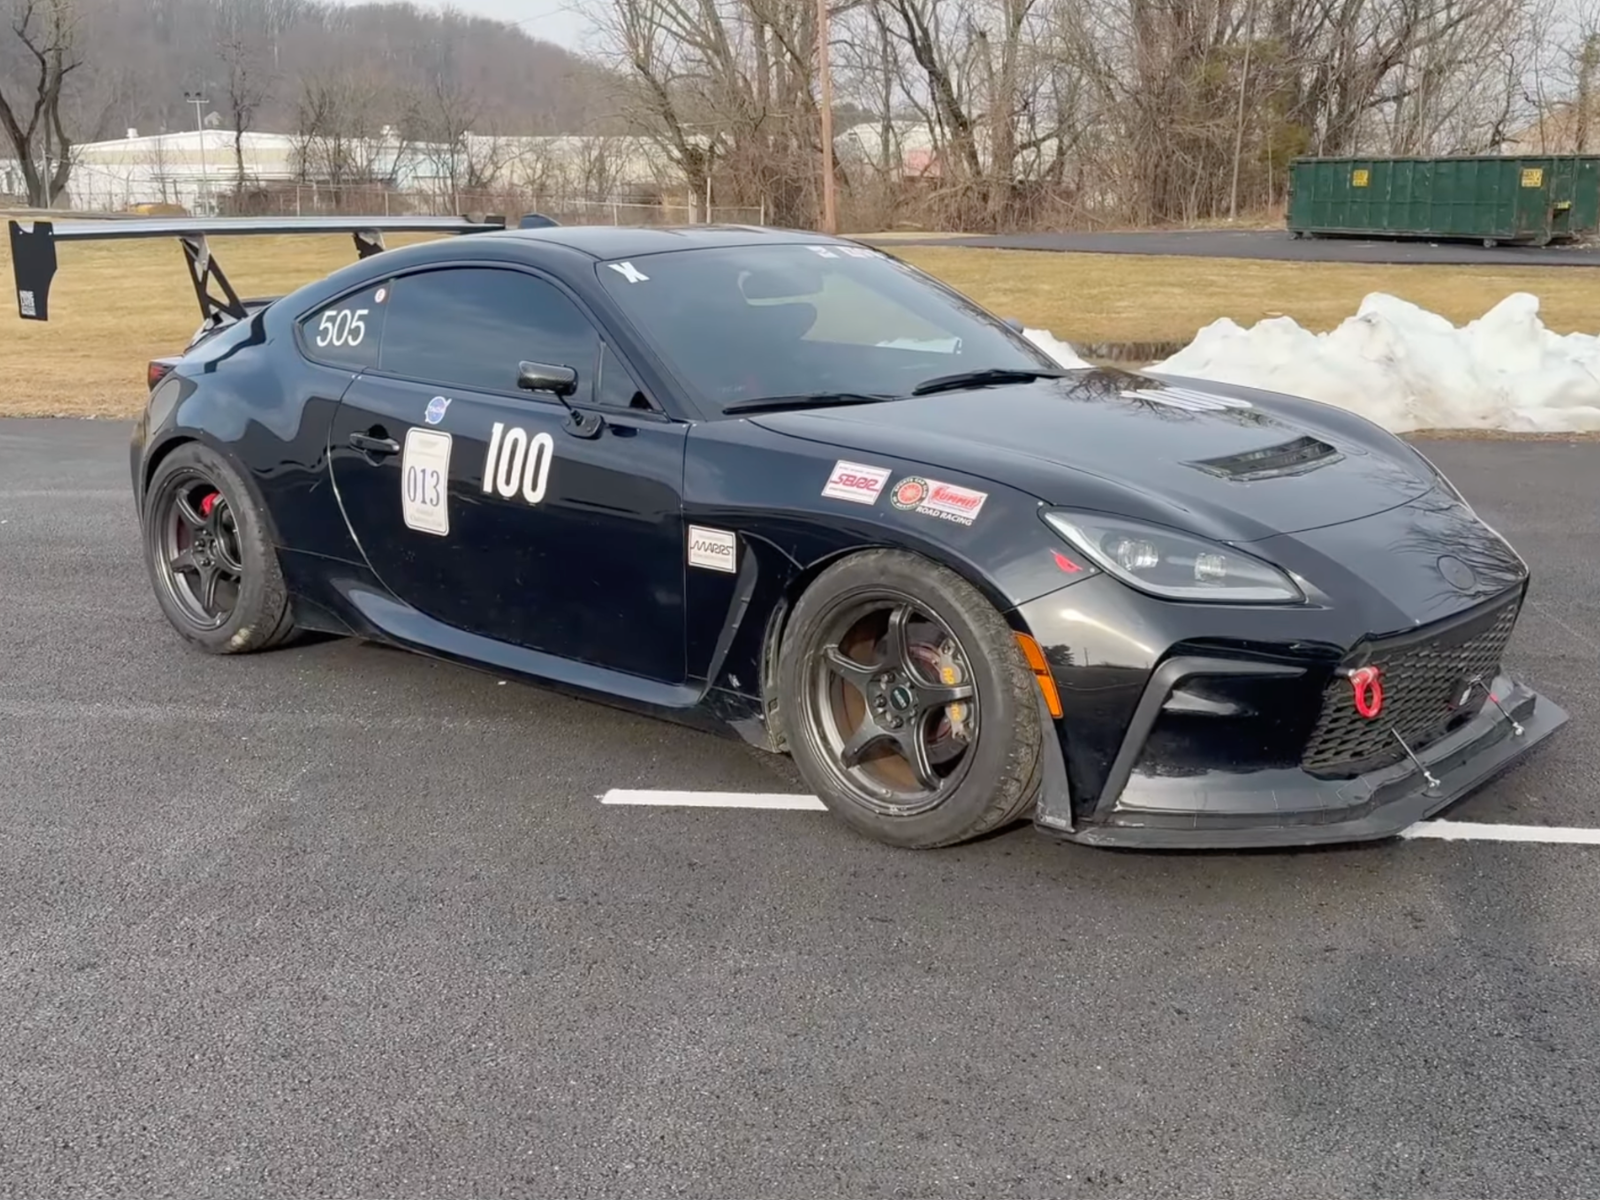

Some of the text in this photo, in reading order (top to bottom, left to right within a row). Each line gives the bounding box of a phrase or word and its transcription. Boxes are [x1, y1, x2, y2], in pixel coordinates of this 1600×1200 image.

[316, 308, 369, 347] 505
[483, 422, 554, 503] 100
[407, 465, 440, 507] 013
[915, 505, 940, 517] ROAD
[940, 512, 973, 526] RACING
